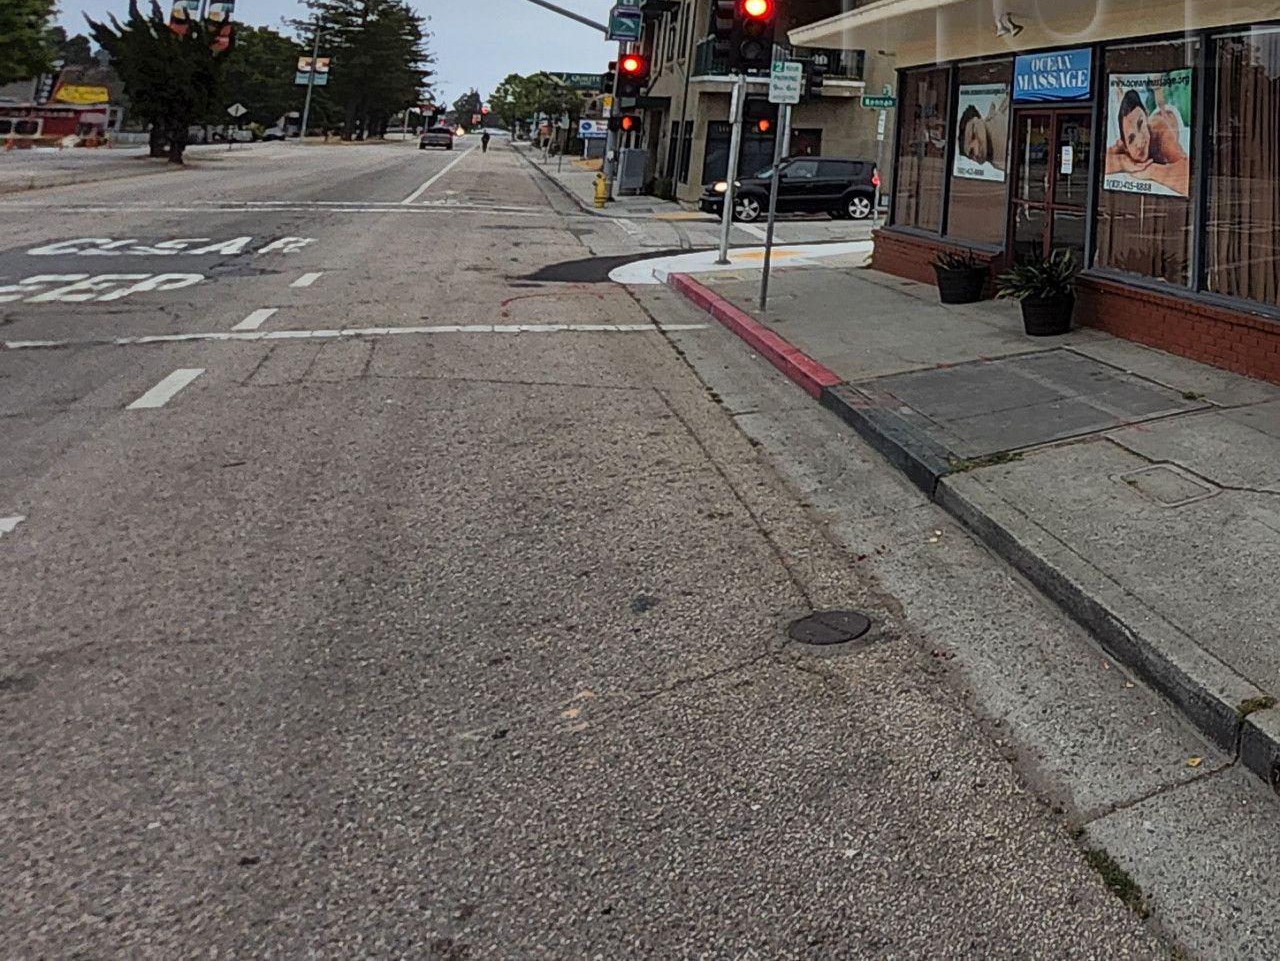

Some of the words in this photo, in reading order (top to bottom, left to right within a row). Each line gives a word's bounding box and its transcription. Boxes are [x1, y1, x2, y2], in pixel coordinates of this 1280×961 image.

[1031, 54, 1072, 72] OCEAN
[1017, 70, 1088, 91] MASSAGE
[27, 237, 318, 255] CLEAR
[0, 273, 205, 303] EEP
